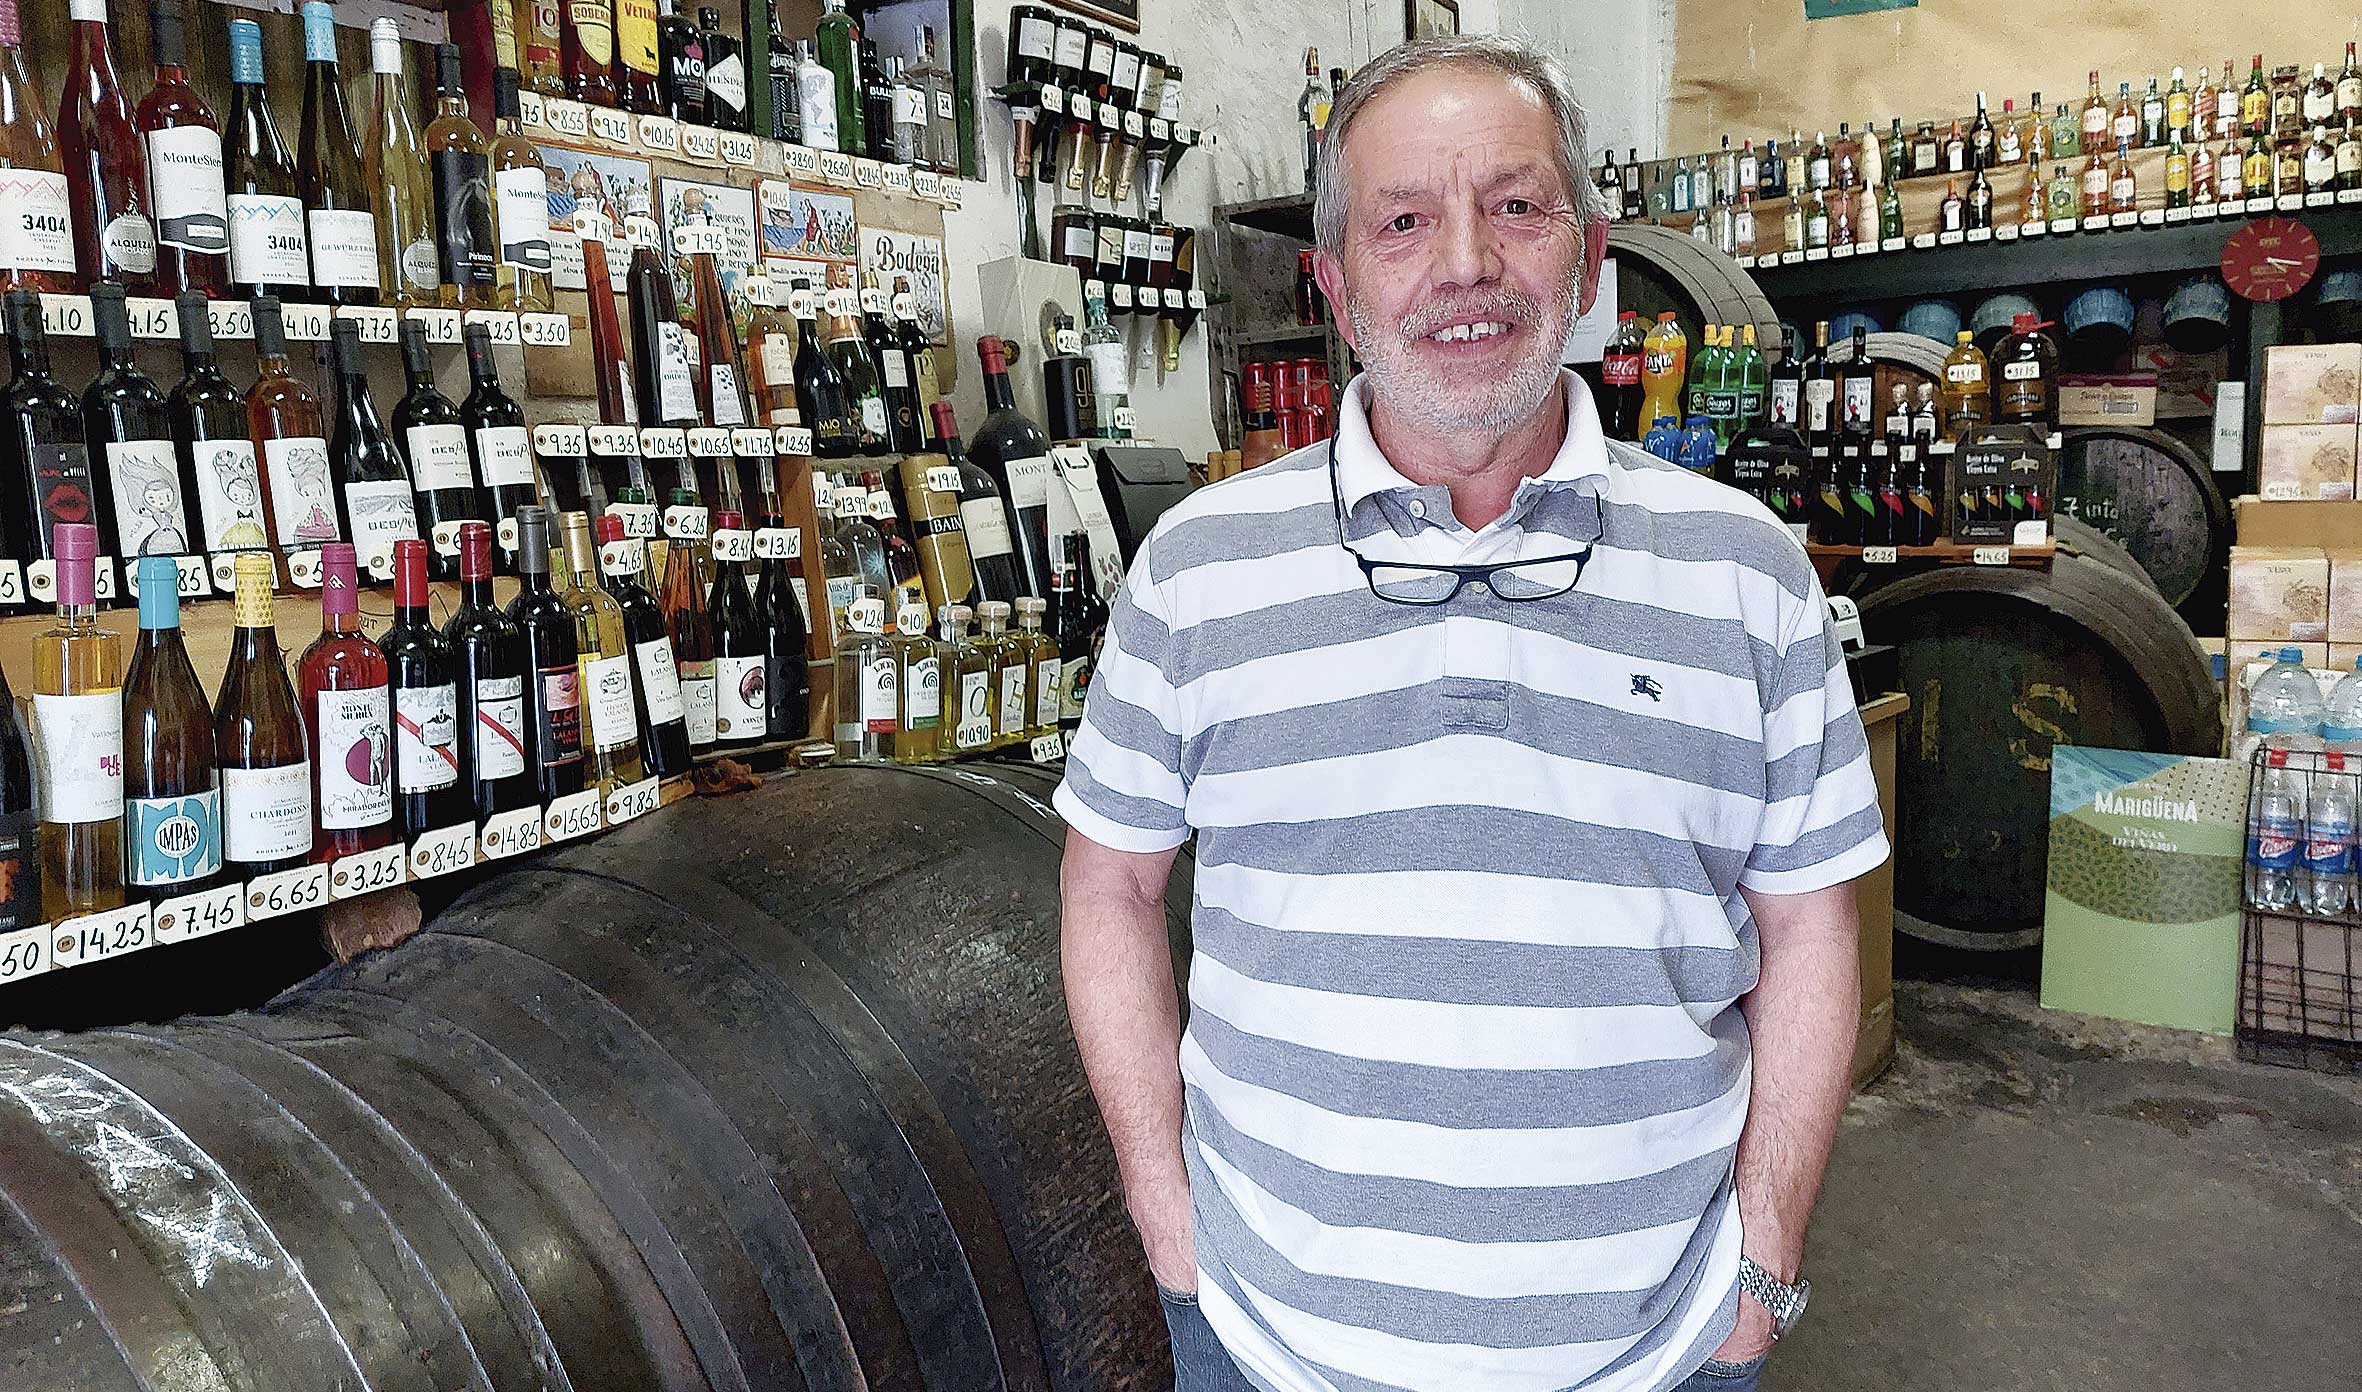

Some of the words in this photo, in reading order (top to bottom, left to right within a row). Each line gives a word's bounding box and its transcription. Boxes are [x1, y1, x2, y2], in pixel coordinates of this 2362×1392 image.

[672, 56, 705, 78] MO
[602, 117, 627, 140] 9.75
[650, 126, 674, 149] 10.15
[22, 213, 66, 235] 3404
[268, 234, 303, 252] 3404
[692, 233, 723, 251] 7.95
[876, 235, 940, 275] Bodega
[285, 314, 321, 338] 4.10
[534, 322, 566, 342] 3.50
[549, 433, 582, 455] 9.35
[603, 433, 636, 455] 9.35
[652, 434, 683, 456] 10.45
[700, 434, 730, 456] 10.65
[743, 434, 772, 456] 11.75
[625, 512, 655, 535] 7.35
[621, 786, 657, 818] 9.85
[563, 801, 600, 834] 15.65
[158, 821, 198, 853] IMPAS
[501, 819, 541, 854] 14.85
[431, 836, 470, 873] 8.45
[350, 854, 400, 891] 3.25
[269, 873, 320, 911] 6.65
[185, 894, 234, 934] 7.45
[79, 912, 147, 960] 14.25
